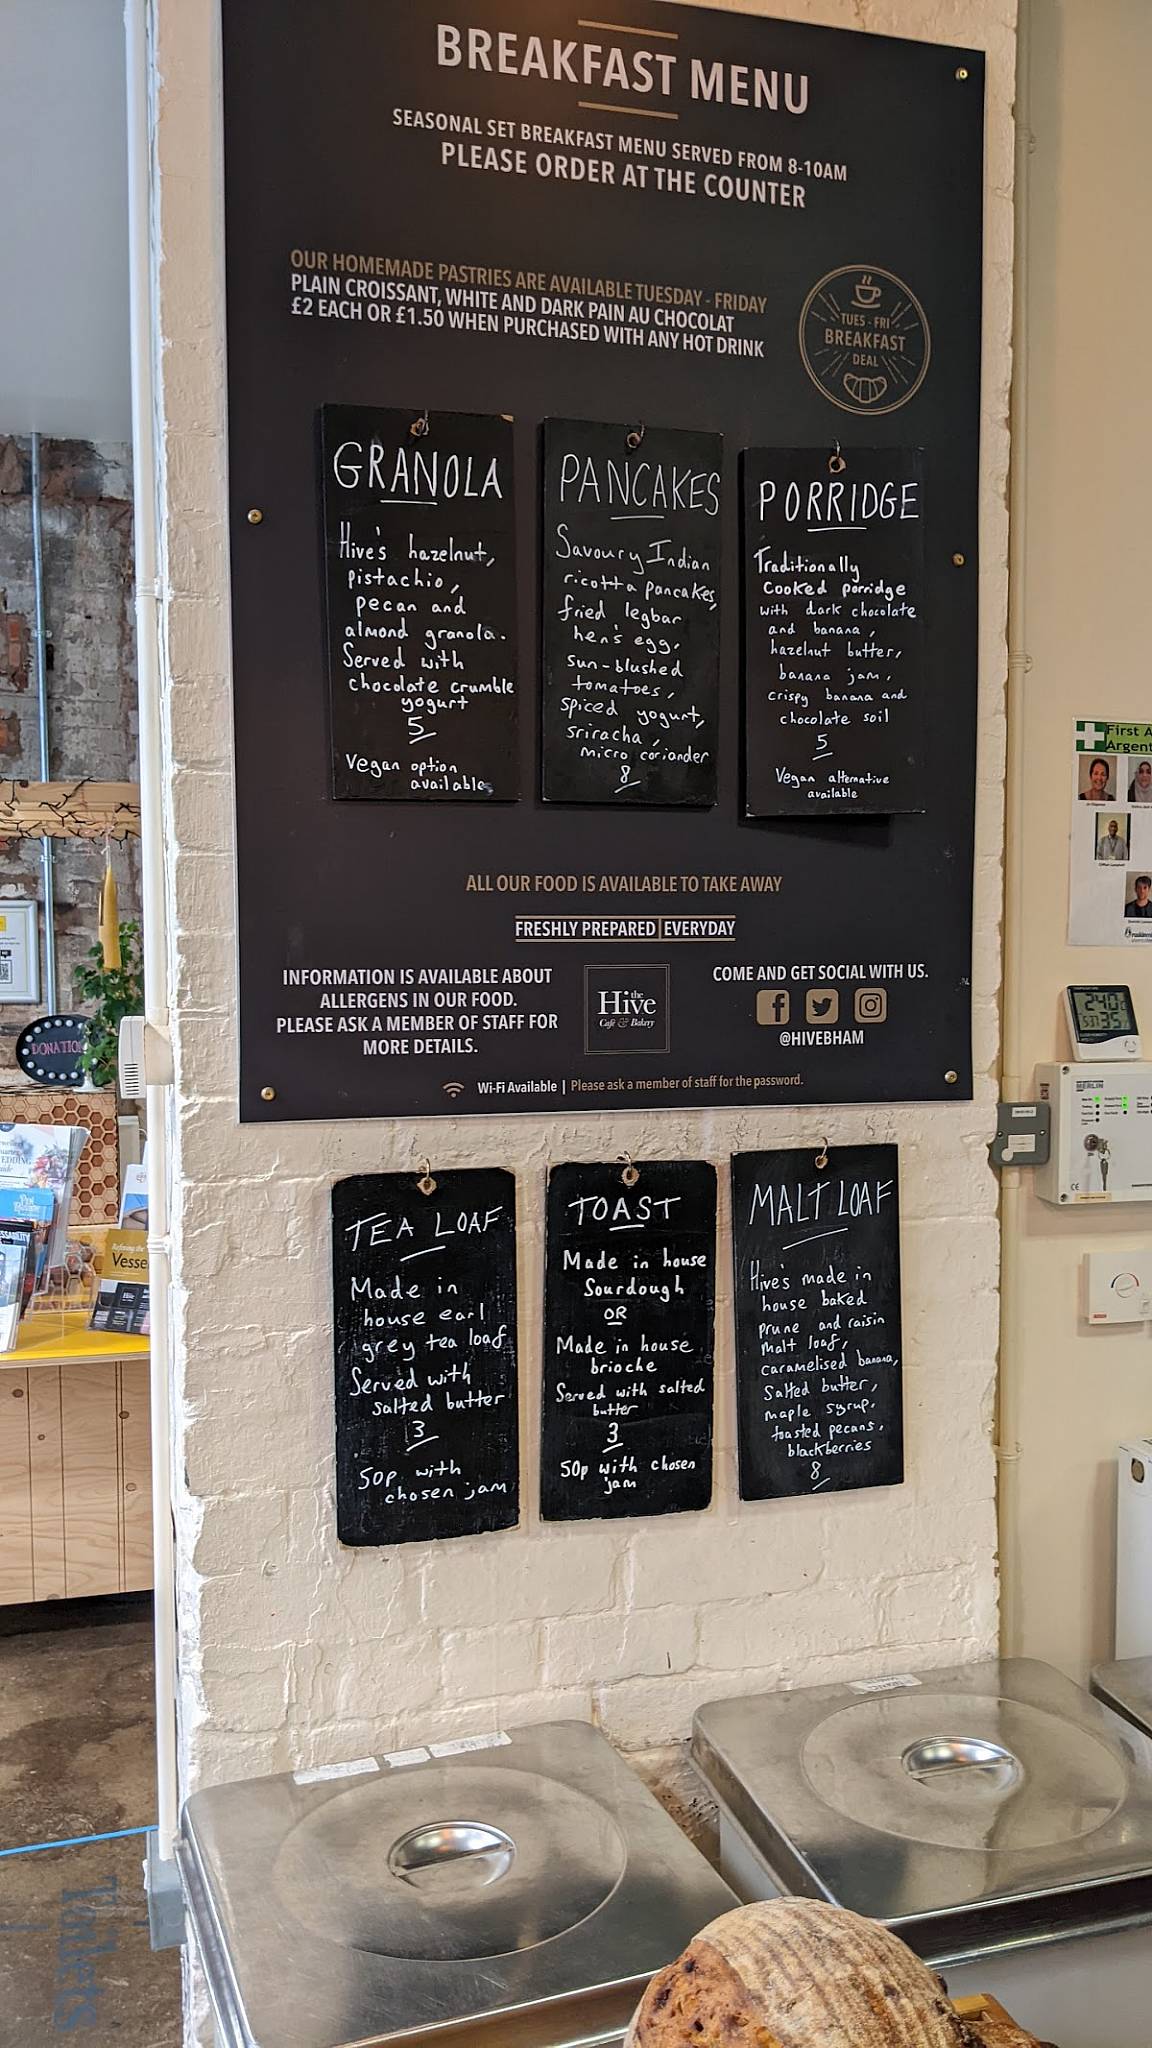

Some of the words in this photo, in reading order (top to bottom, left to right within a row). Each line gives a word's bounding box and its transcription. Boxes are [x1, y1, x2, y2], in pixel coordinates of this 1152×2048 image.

[438, 24, 676, 95] BREAKFAST
[692, 59, 807, 114] MENU
[393, 108, 482, 134] SEASONAL
[487, 120, 516, 138] SET
[521, 124, 613, 150] BREAKFAST
[619, 136, 666, 157] MENU
[672, 143, 732, 165] SERVED
[738, 151, 782, 172] FROM
[788, 158, 846, 181] 8-10AM
[442, 142, 527, 174] PLEASE
[536, 153, 615, 184] ORDER
[622, 164, 648, 188] AT
[654, 167, 695, 194] THE
[704, 174, 805, 208] COUNTER
[291, 250, 327, 269] OUR
[333, 253, 433, 279] HOMEMADE
[439, 264, 511, 287] PASTRIES
[515, 272, 545, 290] ARE
[550, 275, 632, 300] AVAILABLE
[635, 284, 703, 307] TUESDAY
[715, 293, 767, 313] FRIDAY
[292, 273, 340, 295] PLAIN
[346, 278, 441, 307] CROISSANT,
[445, 288, 497, 309] WHITE
[501, 294, 536, 313] AND
[541, 297, 584, 318] DARK
[589, 302, 624, 322] PAIN
[628, 306, 649, 324] AU
[654, 308, 735, 333] CHOCOLAT
[291, 296, 313, 315] £2
[319, 299, 362, 320] EACH
[367, 303, 391, 322] OR
[396, 306, 444, 327] £1.50
[448, 311, 498, 332] WHEN
[504, 316, 599, 341] PURCHASED
[603, 325, 643, 346] WITH
[648, 330, 679, 349] ANY
[683, 334, 713, 352] HOT
[717, 336, 764, 358] DRINK
[840, 312, 866, 326] TUES
[874, 316, 890, 328] FRI
[825, 328, 906, 352] BREAKFAST
[853, 354, 878, 367] DEAL
[334, 440, 502, 498] GRANOLA
[561, 454, 720, 515] PANCAKES
[760, 481, 919, 522] PORRIDGE
[340, 522, 386, 560] Hive's
[409, 534, 494, 566] hazelnut,
[357, 596, 417, 617] pecan
[432, 596, 466, 614] and
[558, 595, 606, 621] fried
[626, 602, 681, 629] legbar
[760, 604, 788, 615] with
[806, 601, 842, 615] dark
[852, 602, 916, 618] chocolate
[346, 618, 408, 639] almond
[425, 624, 505, 650] granola.
[343, 642, 405, 669] Served
[422, 650, 464, 669] with
[771, 639, 831, 657] hazelnut
[848, 642, 901, 658] butter,
[568, 655, 683, 677] sun-blushed
[349, 673, 439, 693] chocolate
[451, 677, 514, 694] crumble
[572, 675, 674, 699] tomatoes,
[780, 711, 851, 725] chocolate
[864, 709, 888, 722] soil
[1106, 724, 1140, 736] First
[466, 875, 493, 891] ALL
[497, 875, 530, 891] OUR
[535, 876, 577, 891] FOOD
[583, 876, 595, 892] IS
[599, 876, 677, 892] AVAILABLE
[680, 876, 698, 892] TO
[702, 876, 737, 892] TAKE
[740, 876, 782, 892] AWAY
[516, 921, 578, 936] FRESHLY
[582, 921, 656, 936] PREPARED
[664, 920, 735, 936] EVERYDAY
[283, 969, 394, 985] INFORMATION
[400, 969, 414, 984] IS
[418, 969, 498, 984] AVAILABLE
[502, 968, 552, 983] ABOUT
[713, 966, 754, 981] COME
[757, 966, 786, 981] AND
[791, 966, 815, 980] GET
[818, 965, 866, 979] SOCIAL
[869, 964, 903, 978] WITH
[908, 964, 928, 978] US.
[320, 993, 408, 1008] ALLERGENS
[413, 993, 429, 1007] IN
[434, 992, 467, 1007] OUR
[472, 992, 517, 1007] FOOD.
[597, 990, 656, 1014] Hive
[630, 990, 644, 998] the
[277, 1017, 333, 1033] PLEASE
[337, 1016, 368, 1032] ASK
[372, 1016, 382, 1032] A
[387, 1016, 454, 1031] MEMBER
[459, 1015, 478, 1030] OF
[483, 1015, 524, 1030] STAFF
[529, 1014, 558, 1029] FOR
[363, 1040, 409, 1055] MORE
[414, 1038, 478, 1054] DETAILS.
[780, 1030, 863, 1046] @HIVEBHAM
[478, 1082, 506, 1094] Wi-Fi
[508, 1080, 558, 1094] Available
[570, 1079, 604, 1092] Please
[607, 1078, 625, 1090] ask
[628, 1081, 634, 1090] a
[636, 1077, 679, 1090] member
[682, 1076, 694, 1088] of
[694, 1075, 718, 1088] staff
[719, 1075, 734, 1088] for
[736, 1075, 752, 1087] the
[754, 1074, 804, 1089] password.
[0, 1155, 31, 1165] EDDING
[568, 1196, 681, 1225] TOAST
[749, 1182, 830, 1226] MALT
[838, 1180, 893, 1216] LOAF
[345, 1213, 414, 1251] TEA
[435, 1206, 503, 1237] LOAF
[563, 1250, 618, 1270] Made
[634, 1255, 648, 1269] in
[663, 1248, 706, 1268] house
[751, 1260, 790, 1291] Hive's
[802, 1265, 847, 1286] made
[856, 1266, 871, 1280] in
[352, 1275, 424, 1302] Made
[438, 1277, 458, 1294] in
[762, 1296, 807, 1312] house
[821, 1290, 867, 1306] baked
[366, 1311, 426, 1332] house
[439, 1303, 484, 1320] earl
[604, 1306, 627, 1319] OR
[591, 1357, 657, 1374] brioche
[788, 1440, 872, 1457] blackberries
[561, 1460, 588, 1480] 50p
[599, 1456, 637, 1474] with
[651, 1455, 695, 1470] chosen
